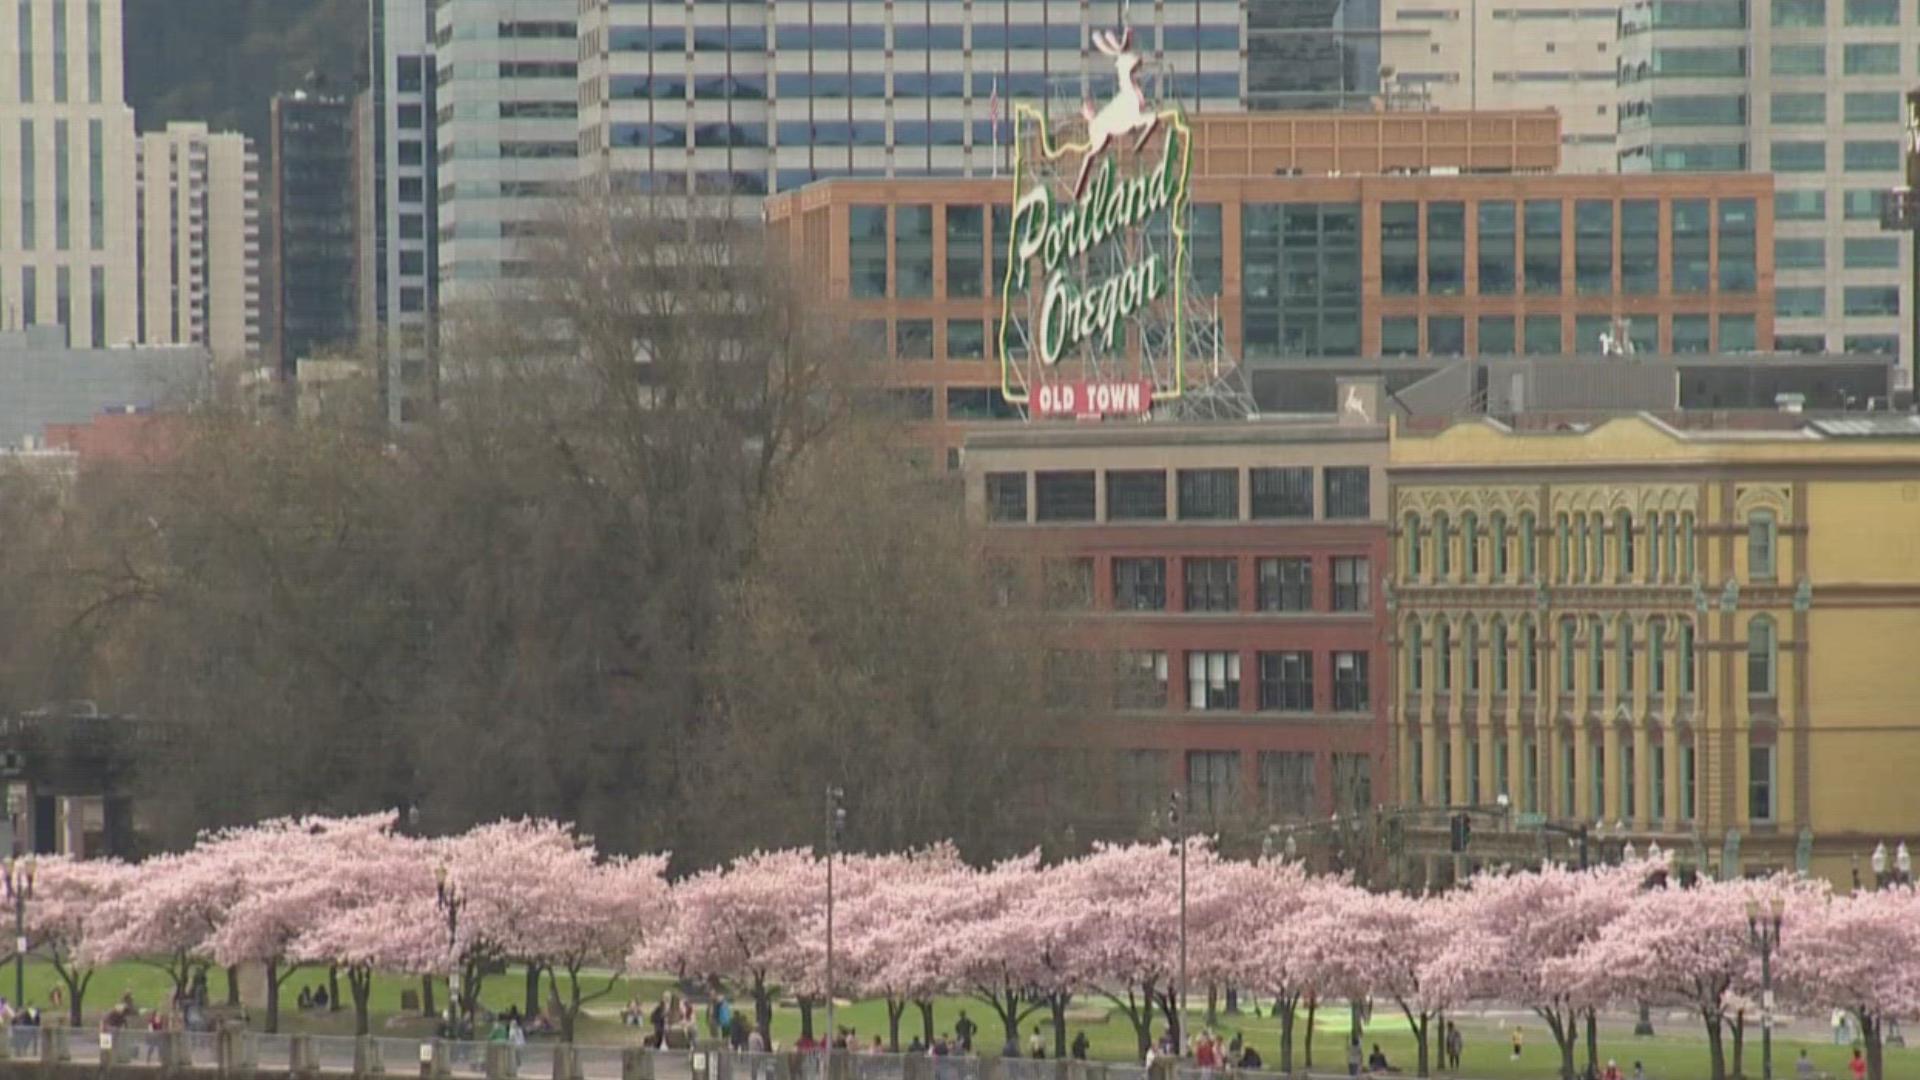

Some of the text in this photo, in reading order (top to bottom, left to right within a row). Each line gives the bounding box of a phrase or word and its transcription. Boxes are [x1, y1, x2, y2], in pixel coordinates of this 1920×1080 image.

[1016, 125, 1177, 288] Portland
[1040, 254, 1162, 364] Oregon
[1039, 383, 1140, 413] OLD TOWN
